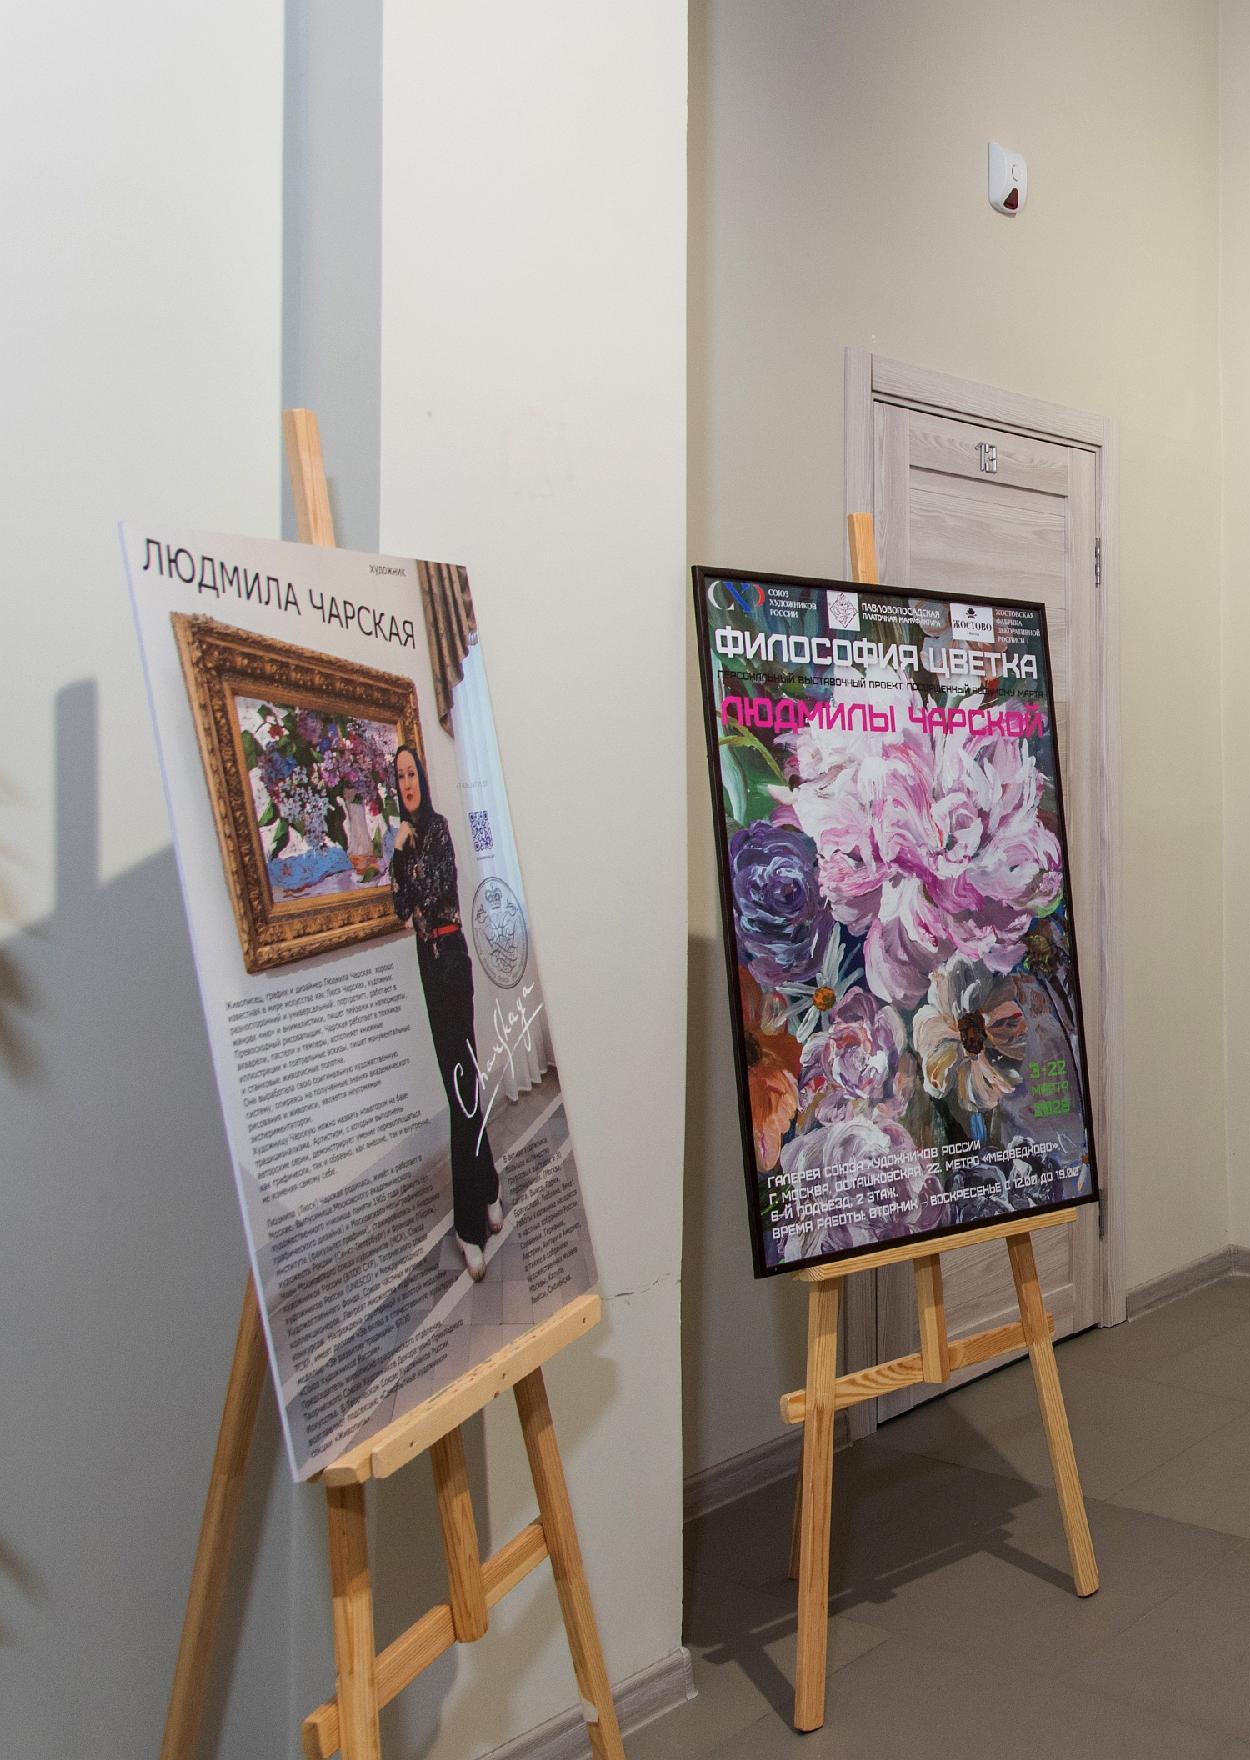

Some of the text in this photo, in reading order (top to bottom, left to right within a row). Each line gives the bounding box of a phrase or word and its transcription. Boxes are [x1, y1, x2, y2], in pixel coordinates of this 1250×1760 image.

[142, 537, 417, 650] ЛЮДМИЛА ЧАРСКАЯ
[768, 588, 789, 598] СОЮЗ
[769, 599, 817, 610] ХУДОЖНИКОВ
[861, 602, 940, 619] ПАВЛОВОПОСАДСКАЯ
[770, 609, 799, 619] РОССИИ
[862, 612, 898, 624] ПЛАТОЧНАЯ
[995, 608, 1034, 619] ЖОСТОВСКАЯ
[953, 619, 992, 632] ЖОСТОВО
[714, 625, 1038, 680] ФИЛОСОФИЯ ЦВЕТКА
[798, 675, 866, 689] ВЫСТАВОЧНЫЙ
[869, 680, 903, 690] ПРОЕКТ
[721, 695, 1044, 738] ЛЮДМИЛЫ ЧАРСКОЙ
[767, 1139, 981, 1189] ГАЛЕРЕЯ СОЮЗА ХУДОЖНИКОВ РОССИИ
[768, 1193, 779, 1206] Г.
[945, 1155, 980, 1171] МЕТРО
[772, 1220, 814, 1240] ВРЕМЯ
[818, 1210, 867, 1230] РАБОТЫ:
[869, 1201, 919, 1219] ВТОРНИК
[930, 1181, 1002, 1206] ВОСКРЕСЕНЬЕ
[1040, 1172, 1053, 1185] ДО
[856, 1193, 864, 1205] 2
